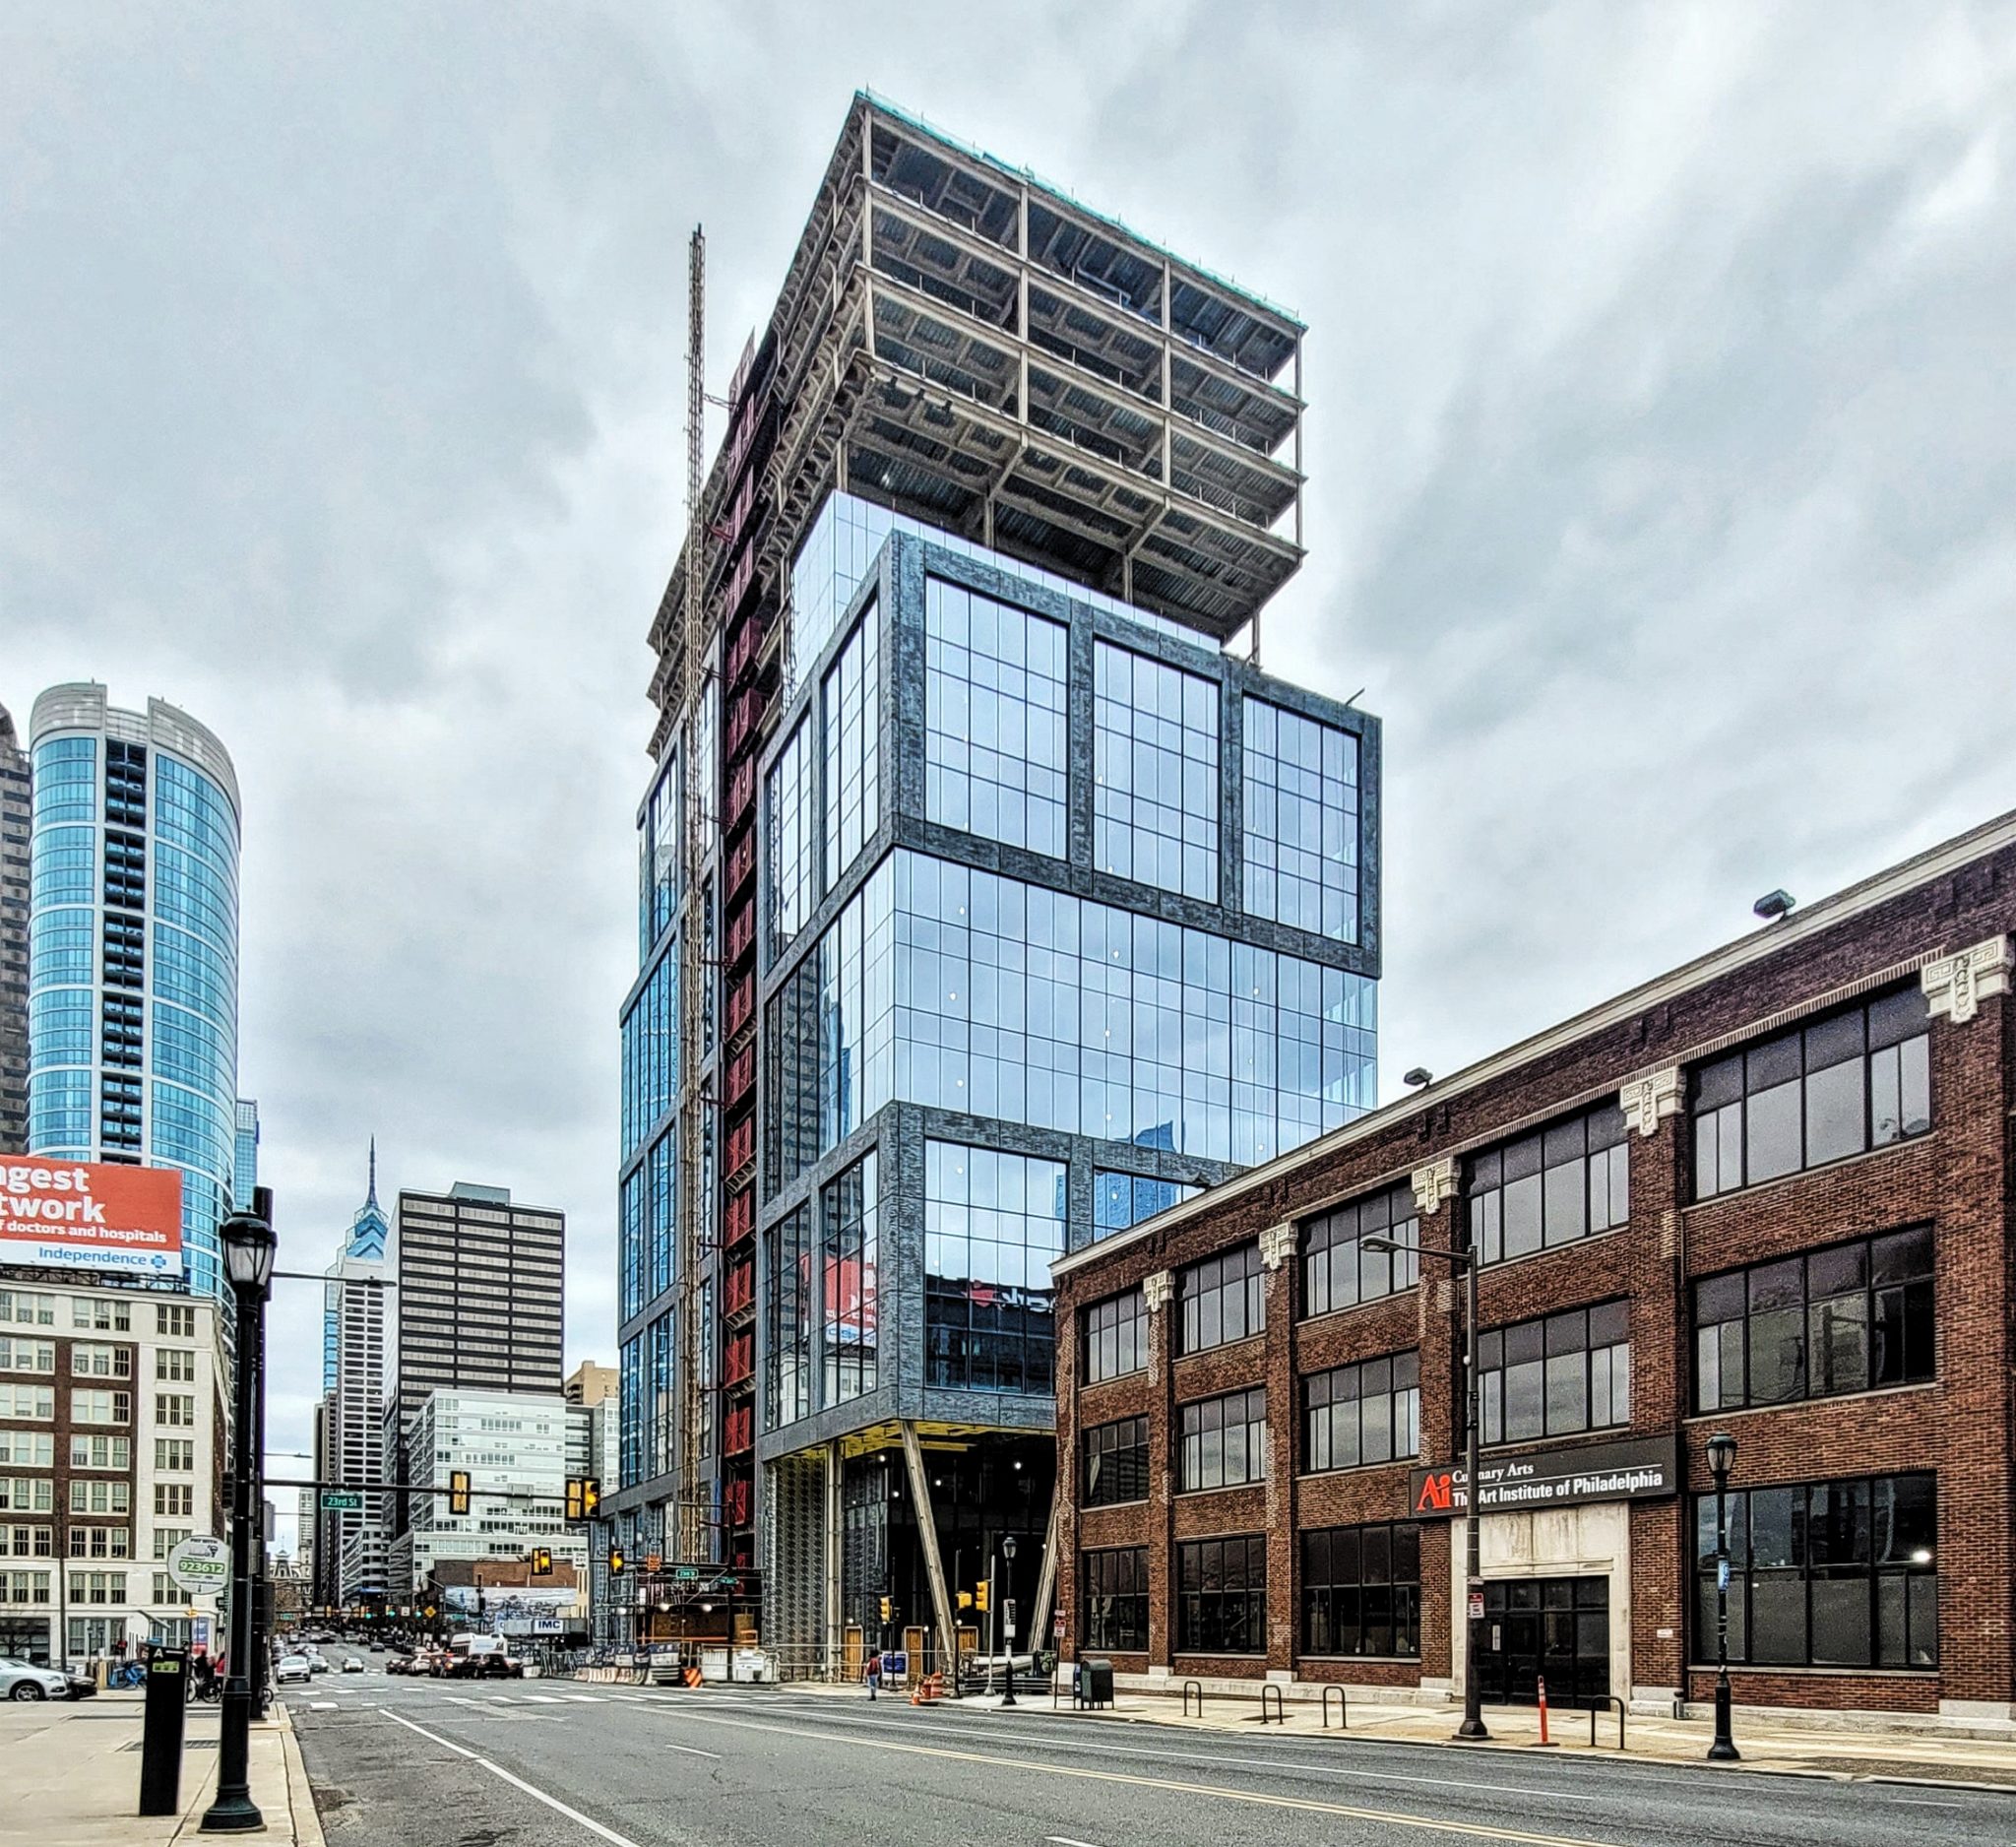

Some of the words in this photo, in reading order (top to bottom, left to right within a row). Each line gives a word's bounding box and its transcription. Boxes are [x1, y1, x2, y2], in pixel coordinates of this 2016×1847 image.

[7, 1220, 66, 1236] doctors
[69, 1226, 97, 1238] and
[99, 1227, 166, 1243] hospitals
[39, 1246, 147, 1266] Independence
[1452, 1467, 1503, 1484] Cunary
[1507, 1463, 1534, 1477] Arts
[1416, 1473, 1452, 1511] Ai
[1452, 1491, 1468, 1507] Th
[1479, 1488, 1497, 1504] Art
[1499, 1483, 1553, 1502] Institute
[1556, 1480, 1571, 1496] of
[1574, 1469, 1663, 1494] Philadelphia
[328, 1497, 347, 1506] 23rd
[348, 1497, 357, 1507] St
[180, 1561, 224, 1573] 923612
[537, 1621, 560, 1629] IMC
